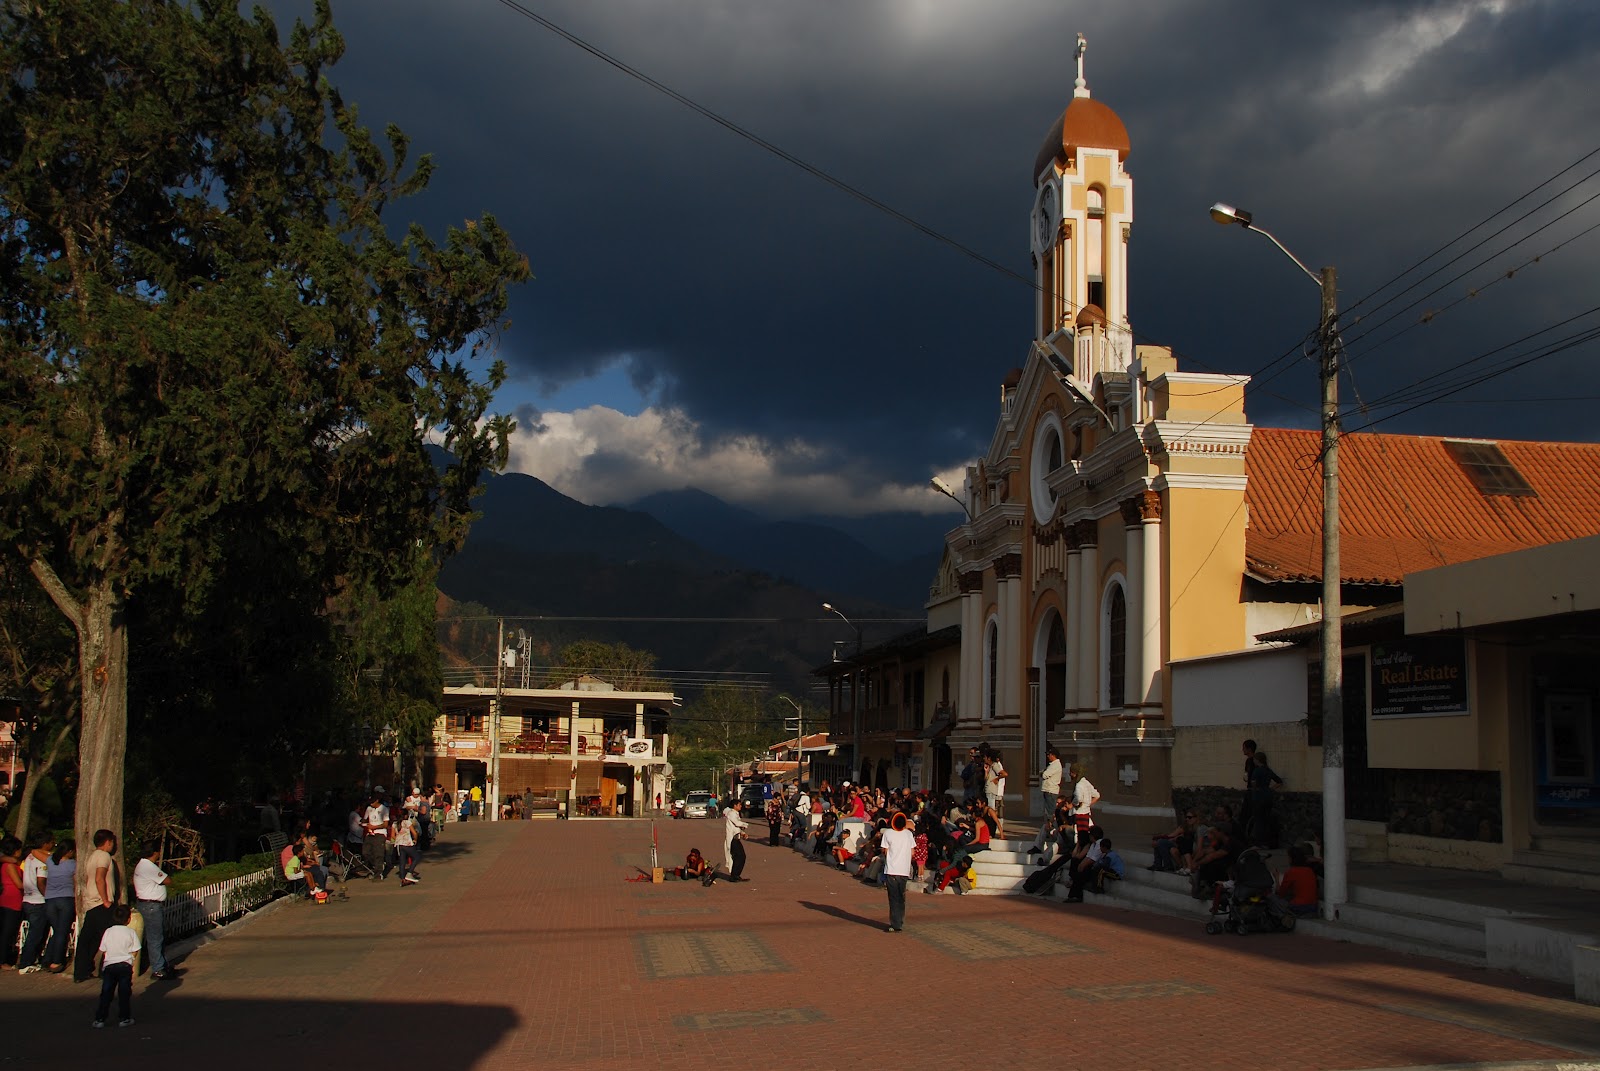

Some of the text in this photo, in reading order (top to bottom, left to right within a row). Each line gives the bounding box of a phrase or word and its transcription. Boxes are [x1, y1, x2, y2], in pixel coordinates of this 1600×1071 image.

[1393, 651, 1413, 665] Valley
[1380, 664, 1458, 685] Real Estate
